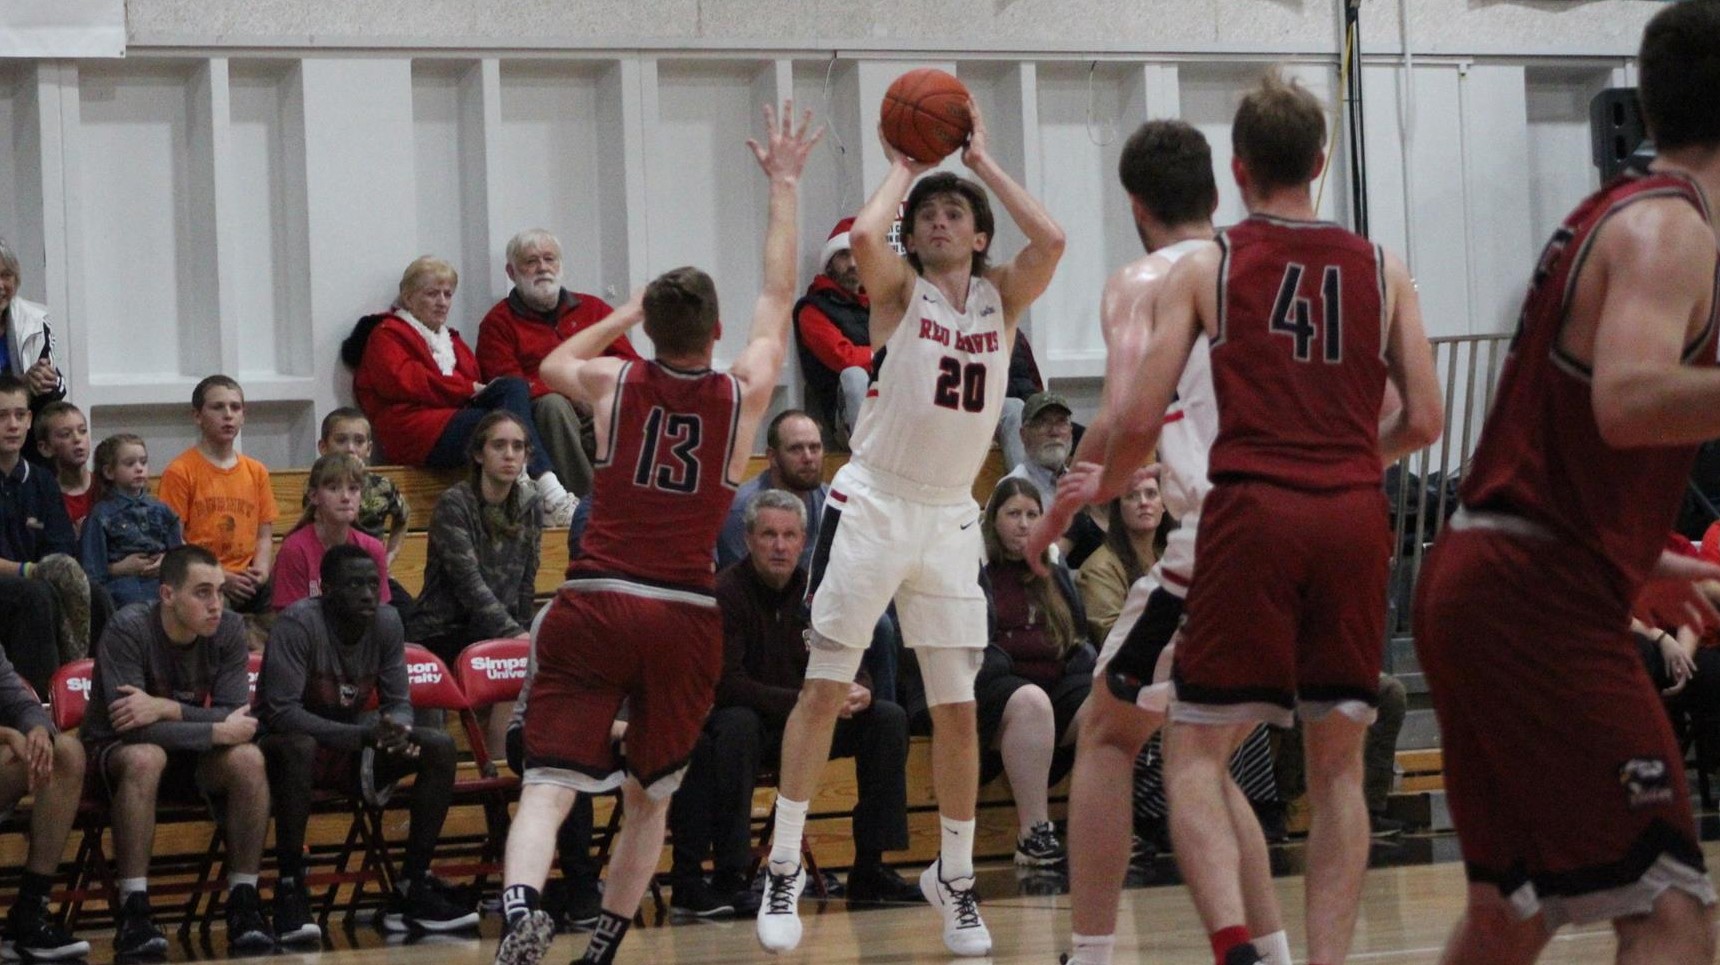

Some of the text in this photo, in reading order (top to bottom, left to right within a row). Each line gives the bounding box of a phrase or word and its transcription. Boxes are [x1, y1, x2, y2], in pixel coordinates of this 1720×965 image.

[1268, 261, 1342, 364] 41
[918, 317, 951, 348] RED
[933, 355, 987, 414] 20
[632, 405, 703, 495] 13
[408, 672, 442, 684] rsity
[470, 656, 528, 670] Simps
[486, 669, 528, 680] Unive
